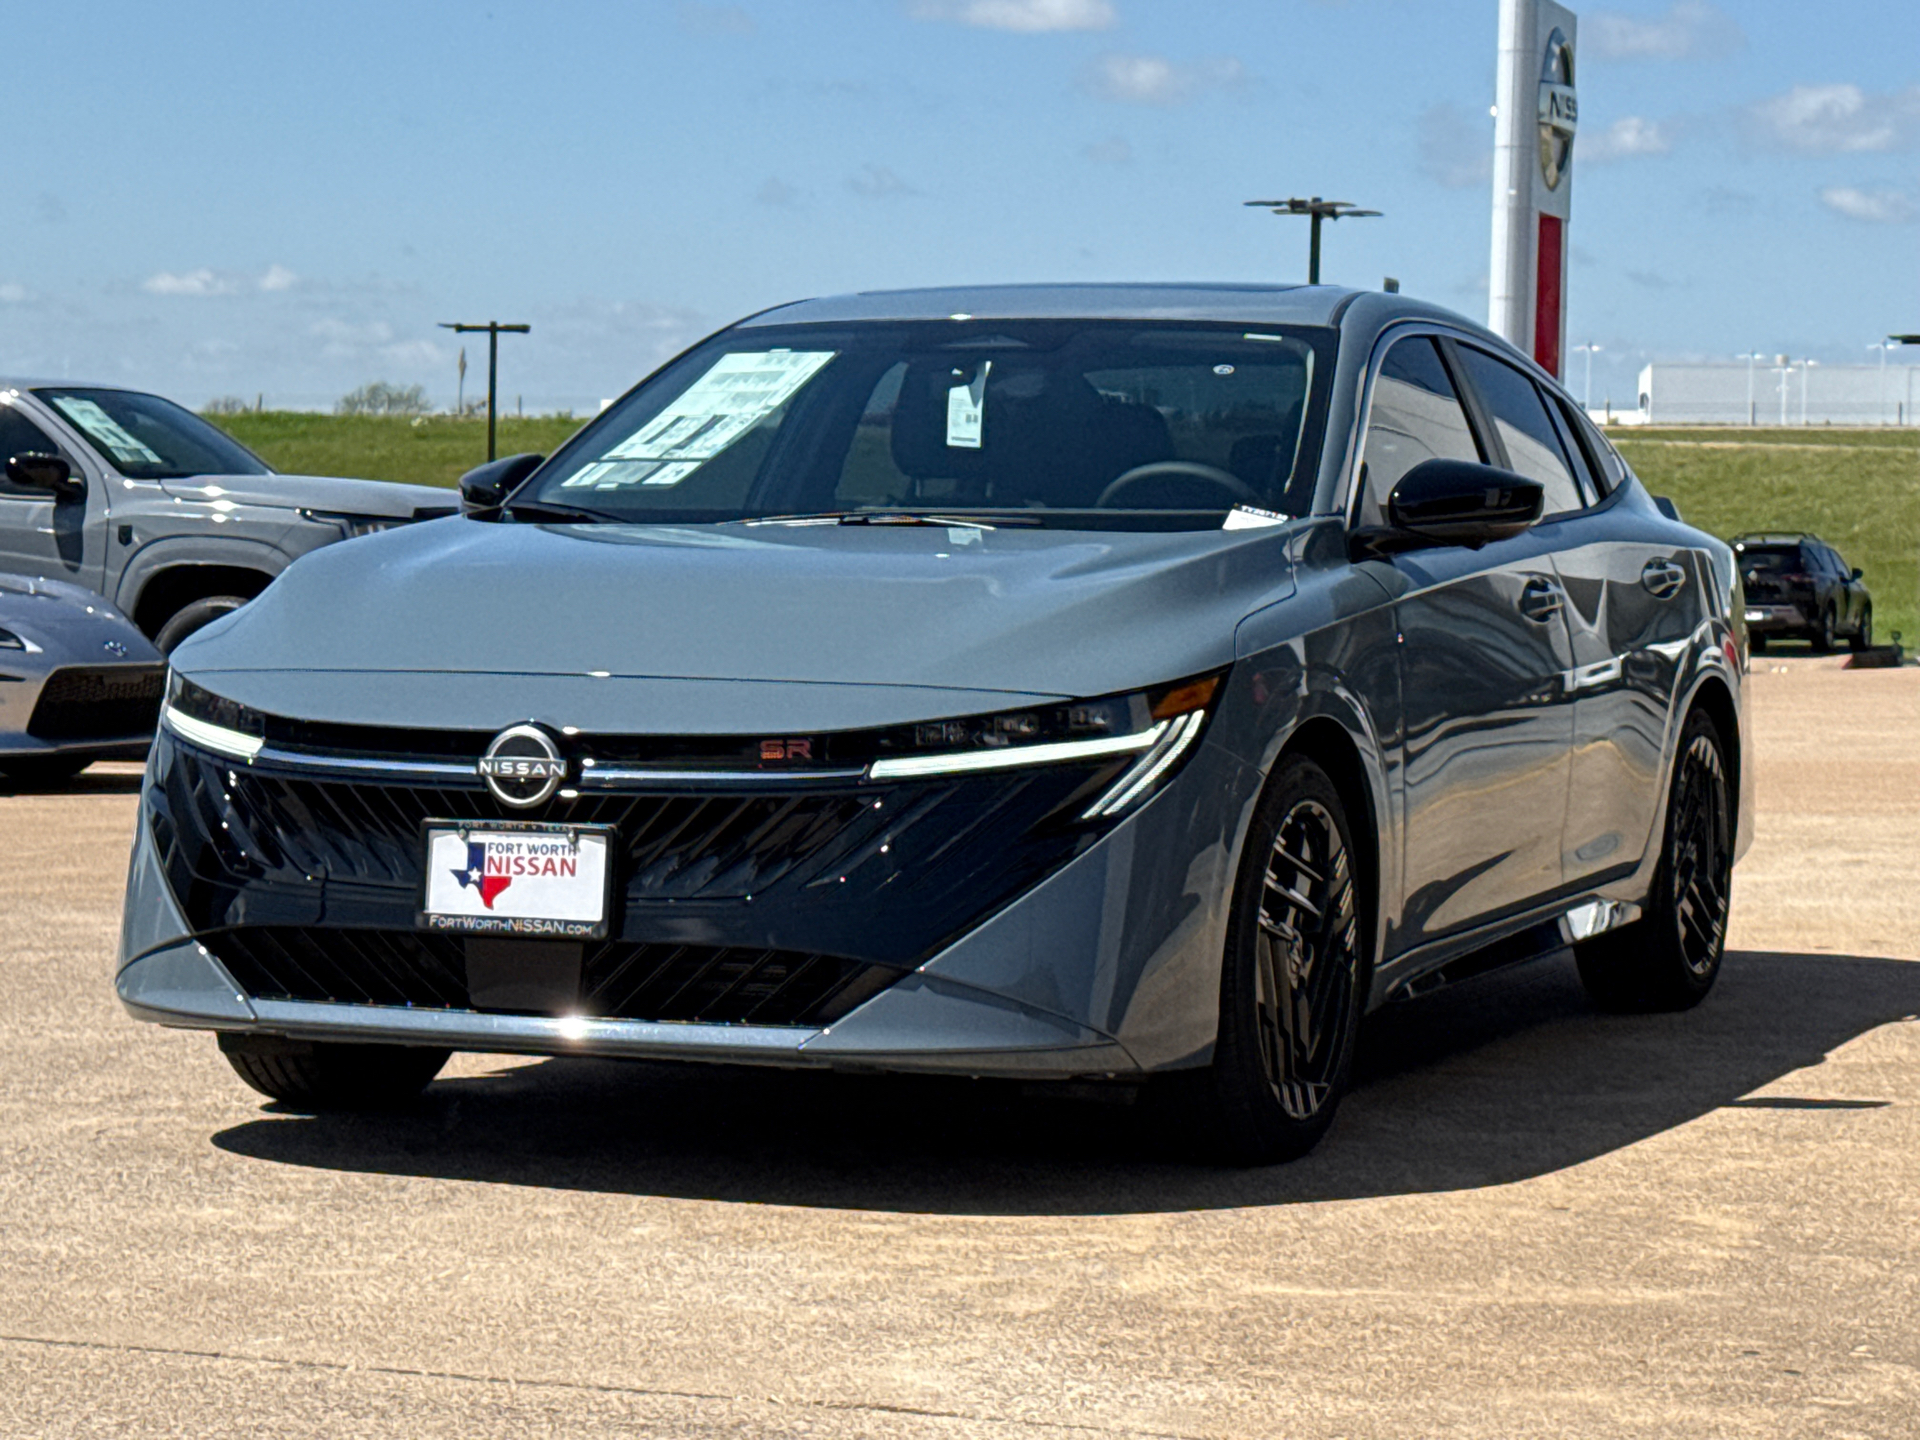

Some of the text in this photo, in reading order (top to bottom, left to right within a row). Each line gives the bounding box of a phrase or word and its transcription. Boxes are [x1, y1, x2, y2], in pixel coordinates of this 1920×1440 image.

[760, 739, 812, 759] SR
[480, 761, 565, 776] NISSAN
[490, 822, 526, 831] WORTH
[487, 842, 577, 856] FORT WORTH
[487, 856, 577, 877] NISSAN
